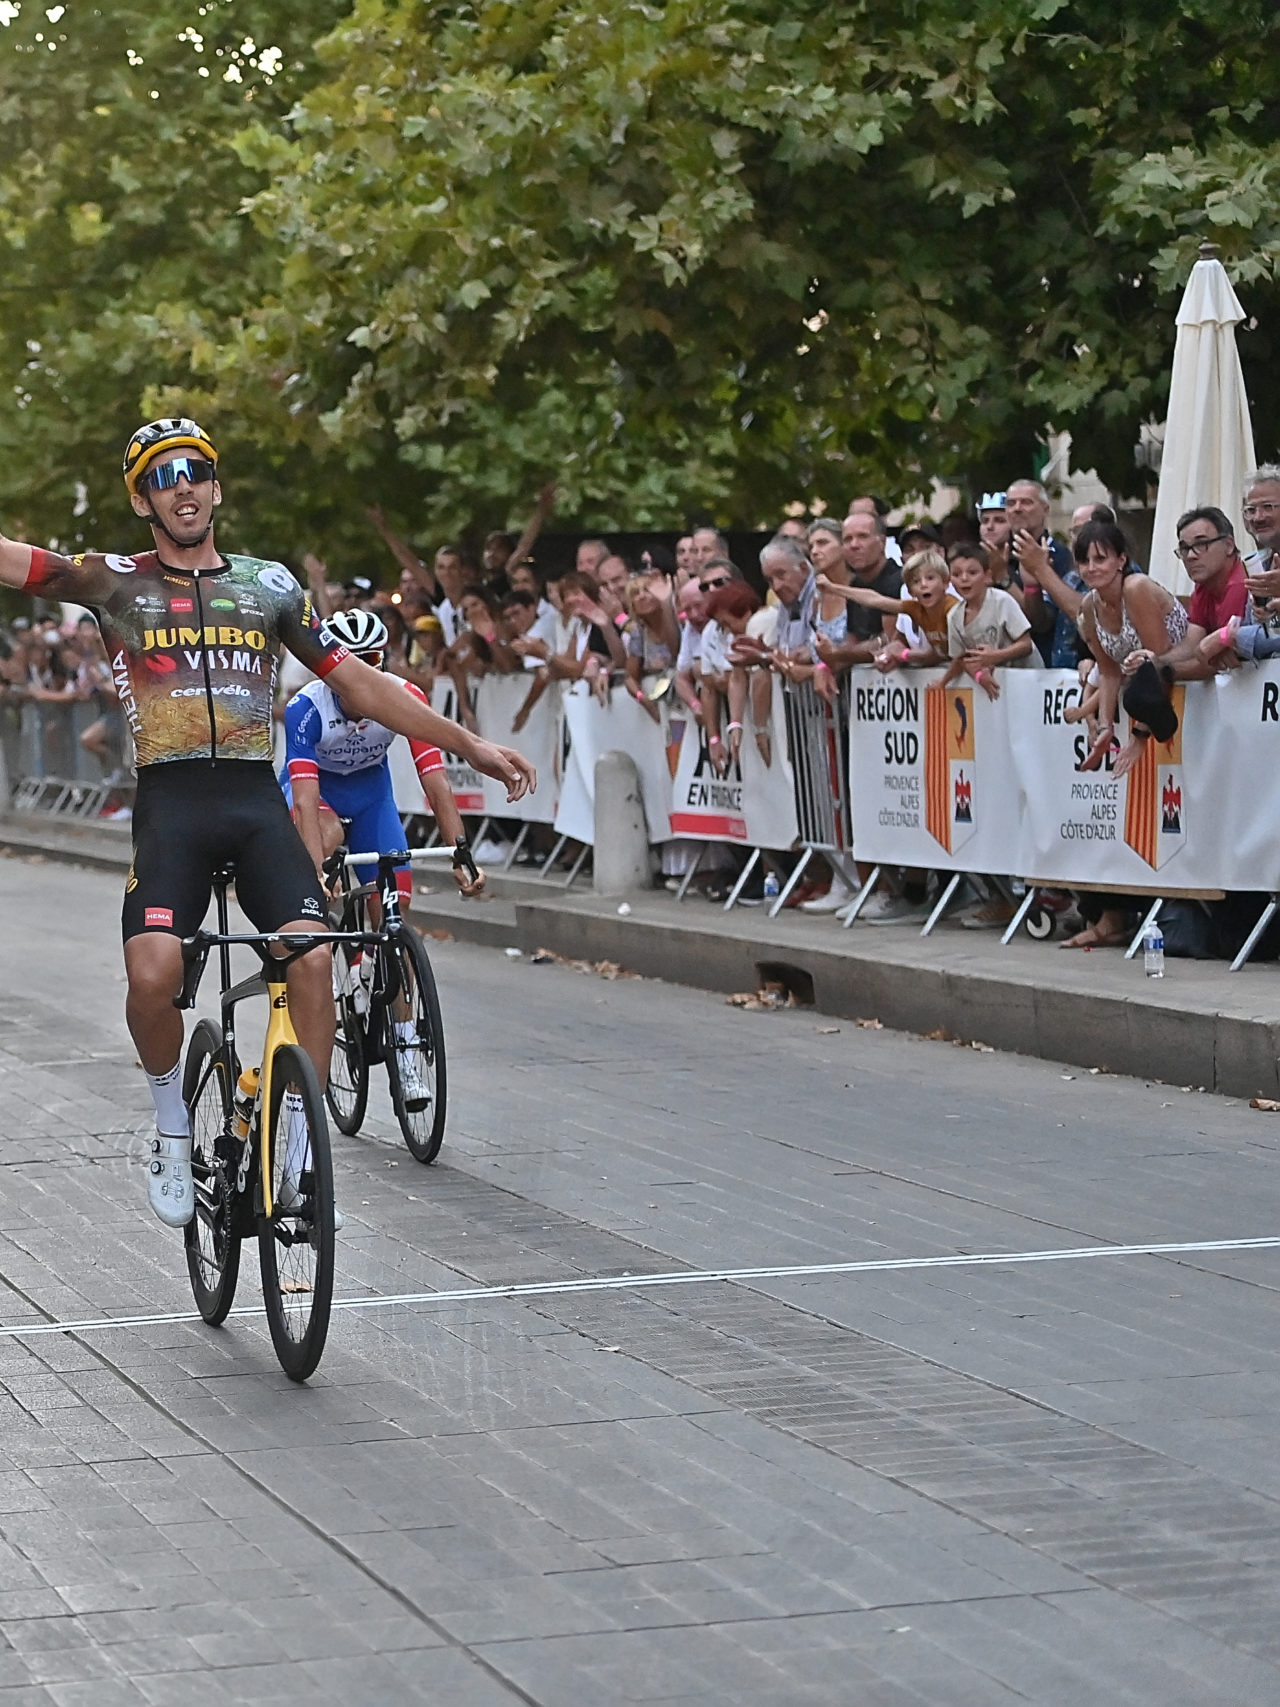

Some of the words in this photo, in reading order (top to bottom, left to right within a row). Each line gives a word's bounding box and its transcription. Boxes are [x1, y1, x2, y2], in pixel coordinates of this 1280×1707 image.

[142, 626, 266, 650] JUMBO
[183, 649, 262, 675] VISMA
[170, 684, 251, 698] cervélo
[884, 731, 919, 765] SUD
[687, 784, 708, 806] EN
[1071, 783, 1118, 800] PROVENCE
[1091, 804, 1116, 820] ALPES
[1061, 819, 1085, 840] CÔTE
[146, 913, 171, 921] HEMA
